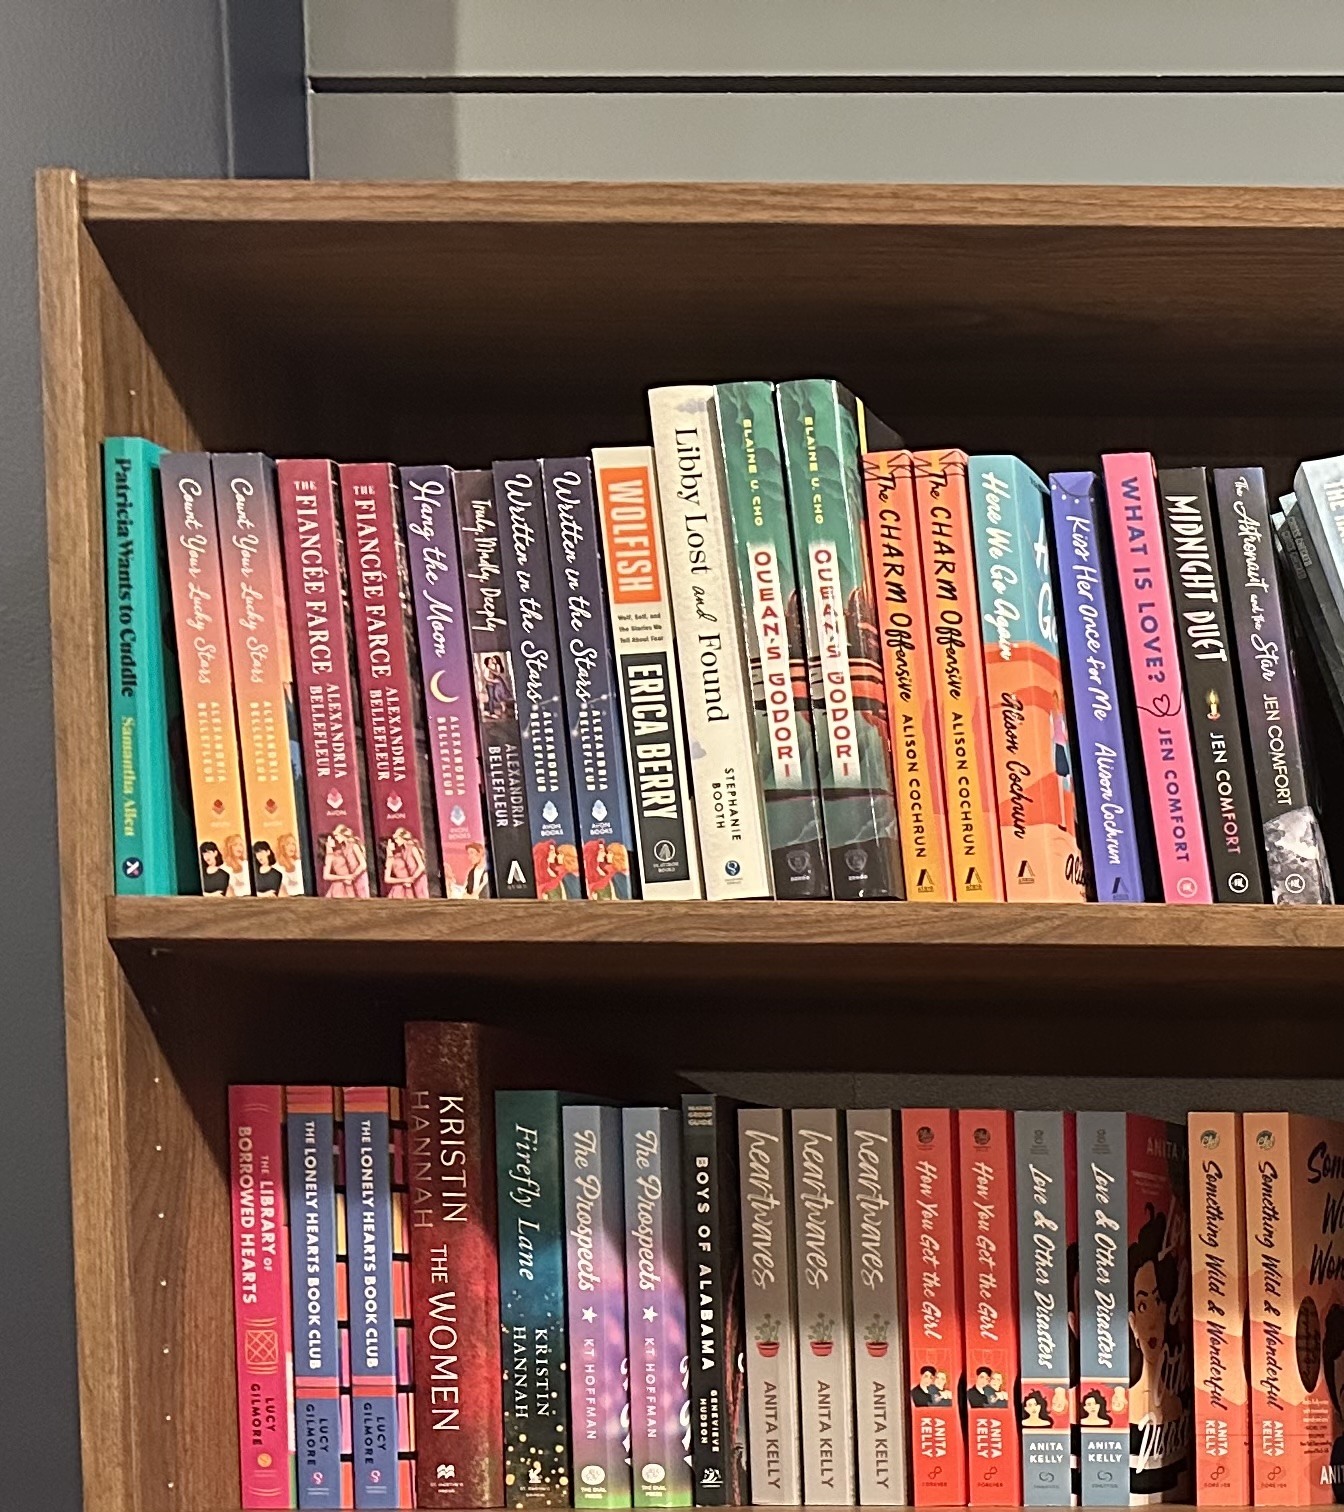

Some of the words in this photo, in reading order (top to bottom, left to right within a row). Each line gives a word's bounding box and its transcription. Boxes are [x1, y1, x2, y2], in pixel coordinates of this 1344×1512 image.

[114, 458, 133, 538] Patricia
[294, 481, 316, 490] THE
[674, 427, 703, 506] Libby
[876, 473, 896, 503] The
[296, 495, 329, 595] FIANCÉE
[608, 479, 654, 592] WOLFISH
[685, 513, 713, 575] Lost
[1121, 476, 1148, 556] WHAT
[1165, 495, 1218, 603] MIDNIGHT
[117, 538, 134, 601] Wants
[879, 508, 907, 604] CHARM
[1133, 566, 1153, 590] IS
[119, 603, 134, 625] to
[306, 601, 332, 675] FARCE
[692, 585, 718, 623] and
[1183, 611, 1227, 662] DUET
[119, 628, 137, 698] Cuddle
[697, 633, 730, 722] Found
[754, 551, 782, 660] OCEAN'S
[768, 672, 794, 778] GODORI
[885, 612, 915, 703] Offensive
[1138, 601, 1166, 684] LOVE?
[309, 685, 331, 778] BELLEFLEUR
[326, 683, 348, 779] ALEXANDRIA
[628, 663, 668, 736] ERICA
[902, 714, 921, 773] ALISON
[1158, 727, 1175, 762] JEN
[637, 743, 678, 819] BERRY
[712, 783, 725, 828] BOOTH
[725, 768, 741, 840] STEPHANIE
[1164, 768, 1190, 863] COMFORT
[908, 777, 926, 858] COCHRUN
[261, 1155, 269, 1174] THE
[305, 1121, 315, 1142] THE
[410, 1090, 433, 1228] HANNAH
[439, 1096, 468, 1222] KRISTIN
[238, 1125, 254, 1228] BORROWED
[304, 1148, 319, 1209] LONELY
[744, 1129, 780, 1290] heartwaves
[261, 1181, 276, 1256] LIBRARY
[306, 1212, 320, 1272] HEARTS
[240, 1232, 257, 1304] HEARTS
[263, 1258, 272, 1272] OF
[431, 1244, 448, 1284] THE
[307, 1278, 321, 1326] BOOK
[308, 1330, 322, 1370] CLUB
[428, 1292, 460, 1432] WOMEN
[764, 1381, 779, 1434] ANITA
[766, 1437, 781, 1489] KELLY
